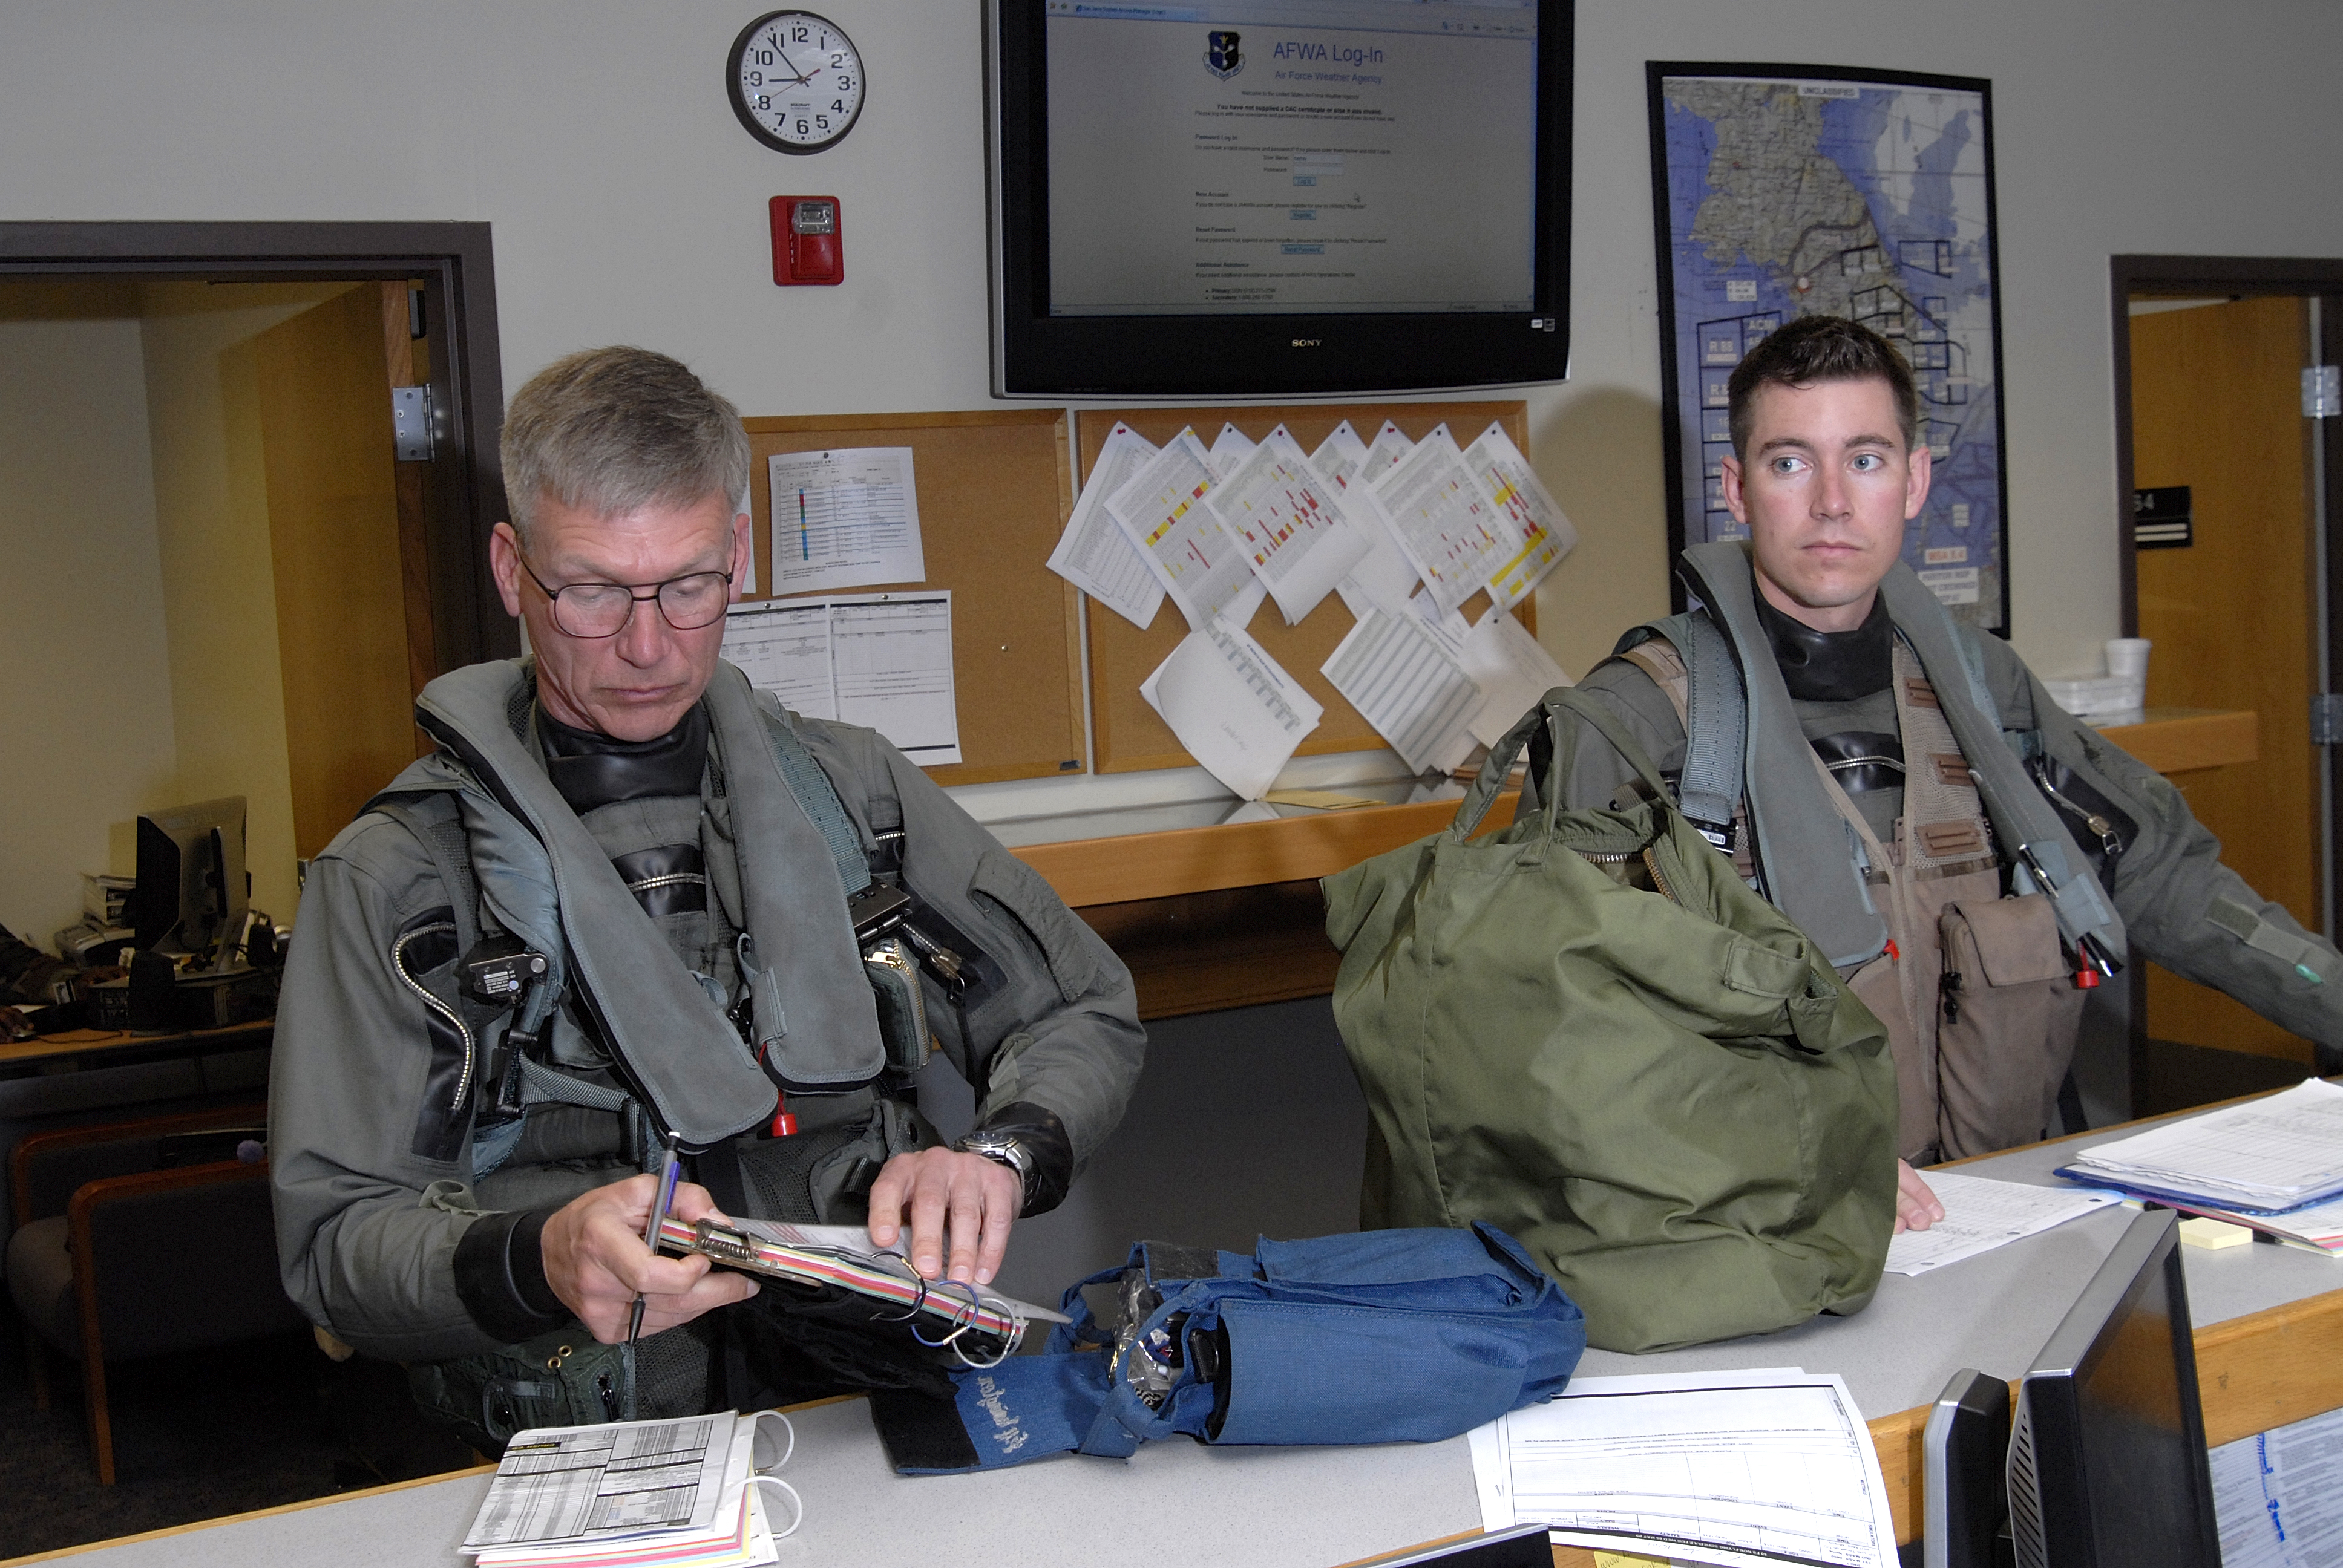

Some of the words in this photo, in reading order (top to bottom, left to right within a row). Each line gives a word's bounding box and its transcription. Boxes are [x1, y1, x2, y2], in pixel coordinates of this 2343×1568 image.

[792, 28, 808, 42] 12
[821, 36, 825, 50] 1
[756, 50, 773, 66] 10
[1273, 41, 1328, 61] AFWA
[1333, 44, 1383, 67] Log-In
[831, 54, 843, 69] 2
[750, 71, 762, 87] 9
[837, 76, 850, 91] 3
[1274, 71, 1286, 79] Air
[1289, 71, 1312, 80] Force
[1316, 73, 1350, 82] Weather
[1352, 74, 1383, 85] Agency
[758, 96, 771, 111] 8
[831, 99, 844, 113] 4
[775, 113, 786, 127] 7
[796, 120, 809, 134] 6
[816, 114, 828, 129] 5
[1291, 339, 1323, 347] SONY
